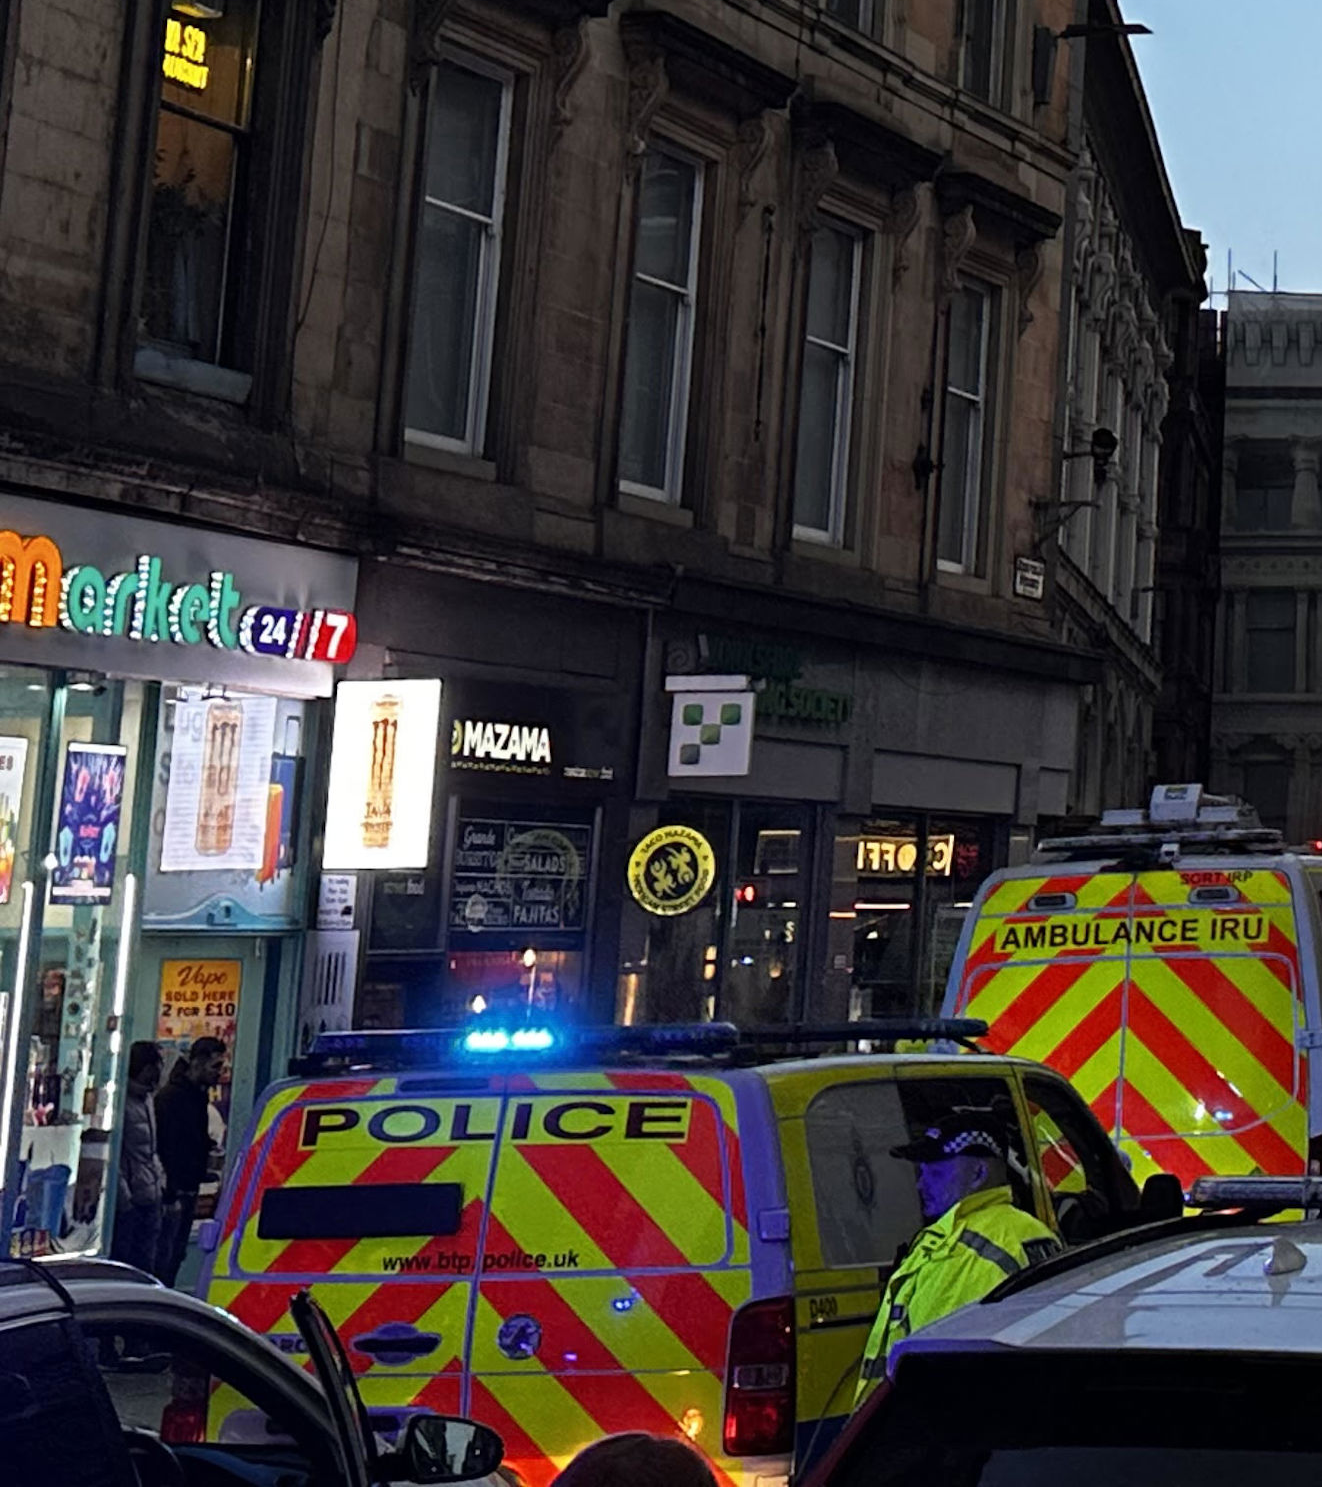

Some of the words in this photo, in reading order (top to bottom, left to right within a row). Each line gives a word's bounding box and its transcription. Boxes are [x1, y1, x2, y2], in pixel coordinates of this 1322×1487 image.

[259, 615, 285, 645] 24
[325, 614, 349, 658] 7
[463, 720, 551, 763] MAZAMA
[1180, 872, 1224, 885] SORT
[1000, 919, 1199, 950] AMBULANCE
[1210, 918, 1263, 941] IRU
[161, 1003, 171, 1017] 2
[204, 1002, 235, 1017] £10
[164, 990, 199, 1003] SOLD
[201, 990, 235, 1002] HERE
[301, 1101, 688, 1147] POLICE
